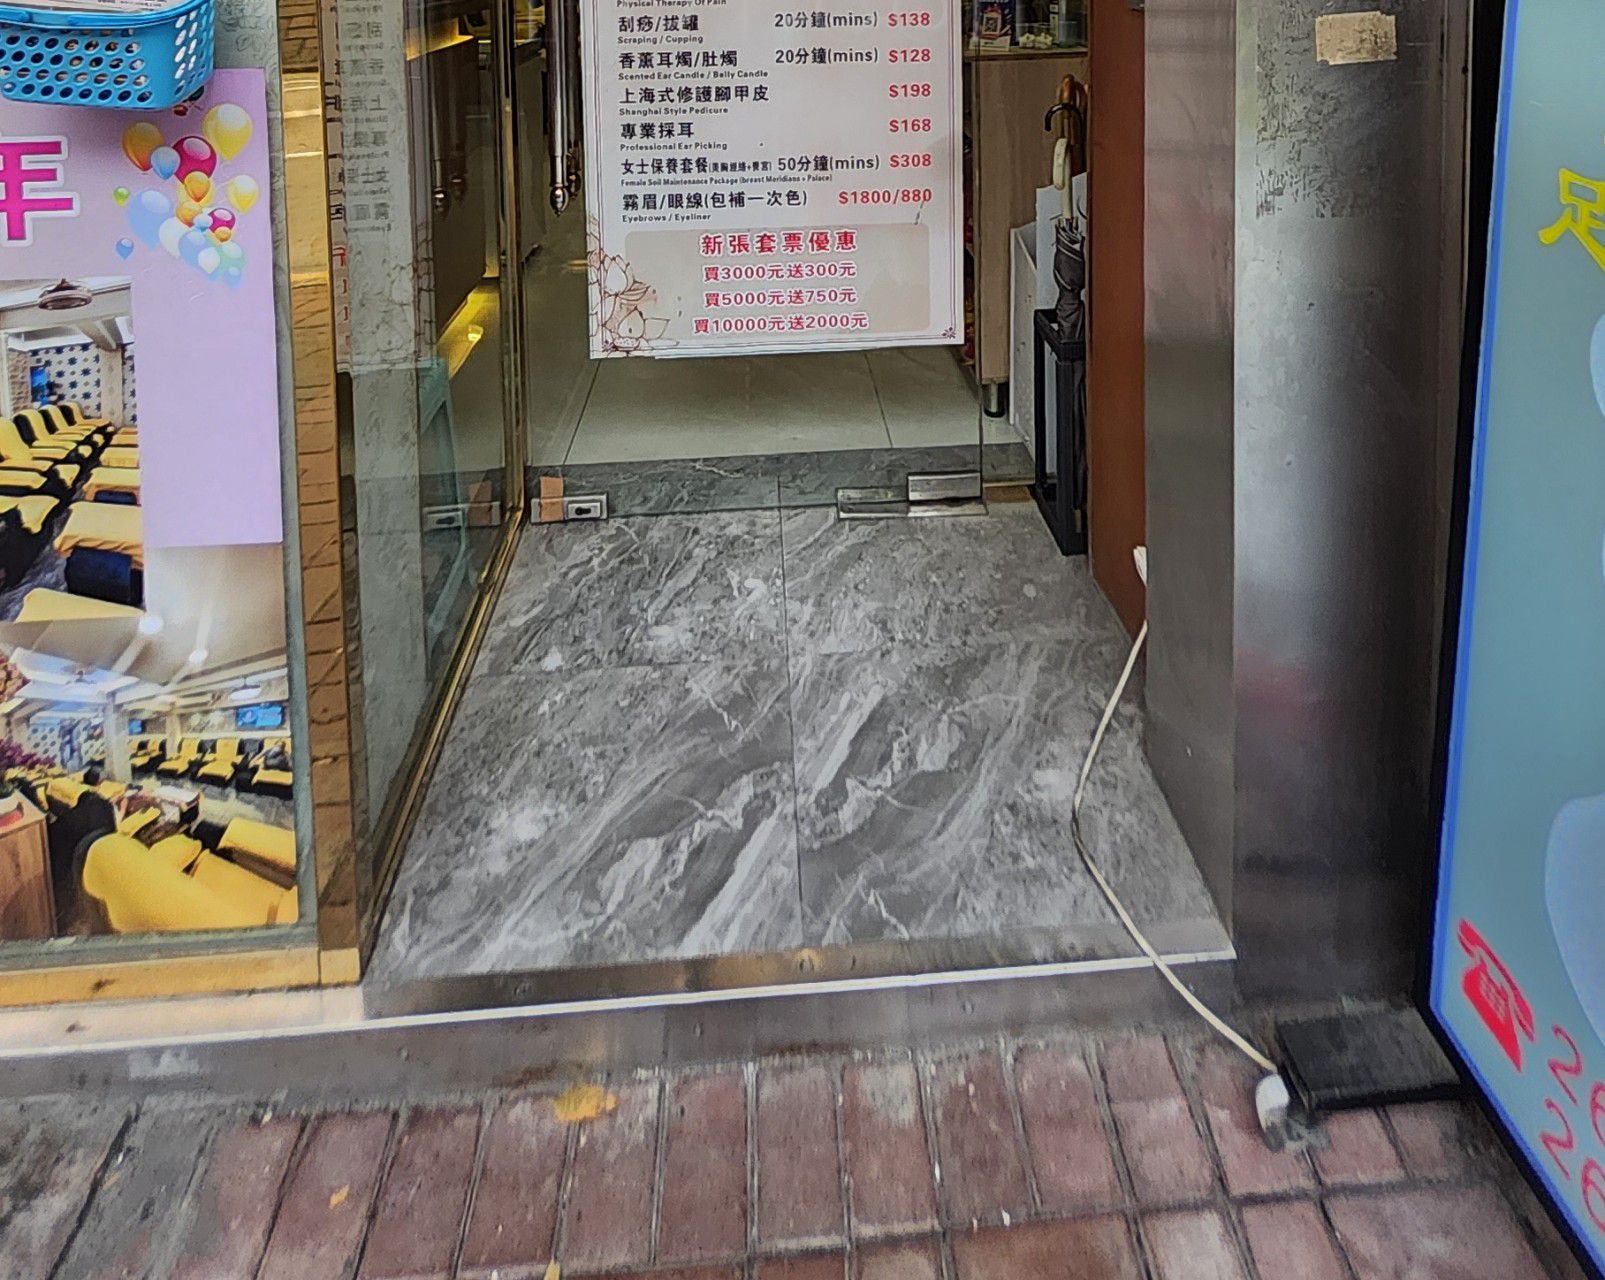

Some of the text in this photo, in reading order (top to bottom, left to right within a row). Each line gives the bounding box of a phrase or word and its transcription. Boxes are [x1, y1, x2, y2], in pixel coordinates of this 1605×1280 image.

[616, 0, 654, 8] Physical
[774, 11, 878, 29] 20分鐘(mins)
[888, 13, 930, 27] $138
[617, 36, 657, 45] Scraping
[665, 35, 704, 44] Cupping
[775, 47, 879, 66] 20分鐘(mins)
[888, 49, 931, 63] $128
[618, 72, 655, 80] Scented
[657, 71, 672, 79] Ear
[673, 71, 705, 79] Candle
[713, 71, 735, 80] Belly
[737, 70, 768, 78] Candle
[889, 84, 931, 98] $198
[619, 106, 728, 117] Shanghai Style Pedicure
[620, 119, 932, 140] 專業採耳 $168
[620, 143, 676, 151] Professional
[695, 142, 728, 151] Picking
[778, 154, 880, 173] 50分鐘(mins)
[889, 153, 932, 168] $308
[621, 179, 647, 187] Female
[663, 178, 708, 186] Maintenance
[709, 177, 738, 185] Package
[766, 175, 800, 183] Meridians
[622, 189, 932, 211] 霧眉/眼線(包補一次色) $1800/880
[622, 214, 666, 223] Eyebrows
[674, 213, 711, 222] Eyeliner
[701, 230, 857, 255] 新張套票優惠
[703, 262, 857, 282] 買3000元送300元
[704, 287, 857, 308] 買5000元送750元
[694, 313, 868, 334] 買10000元送2000元
